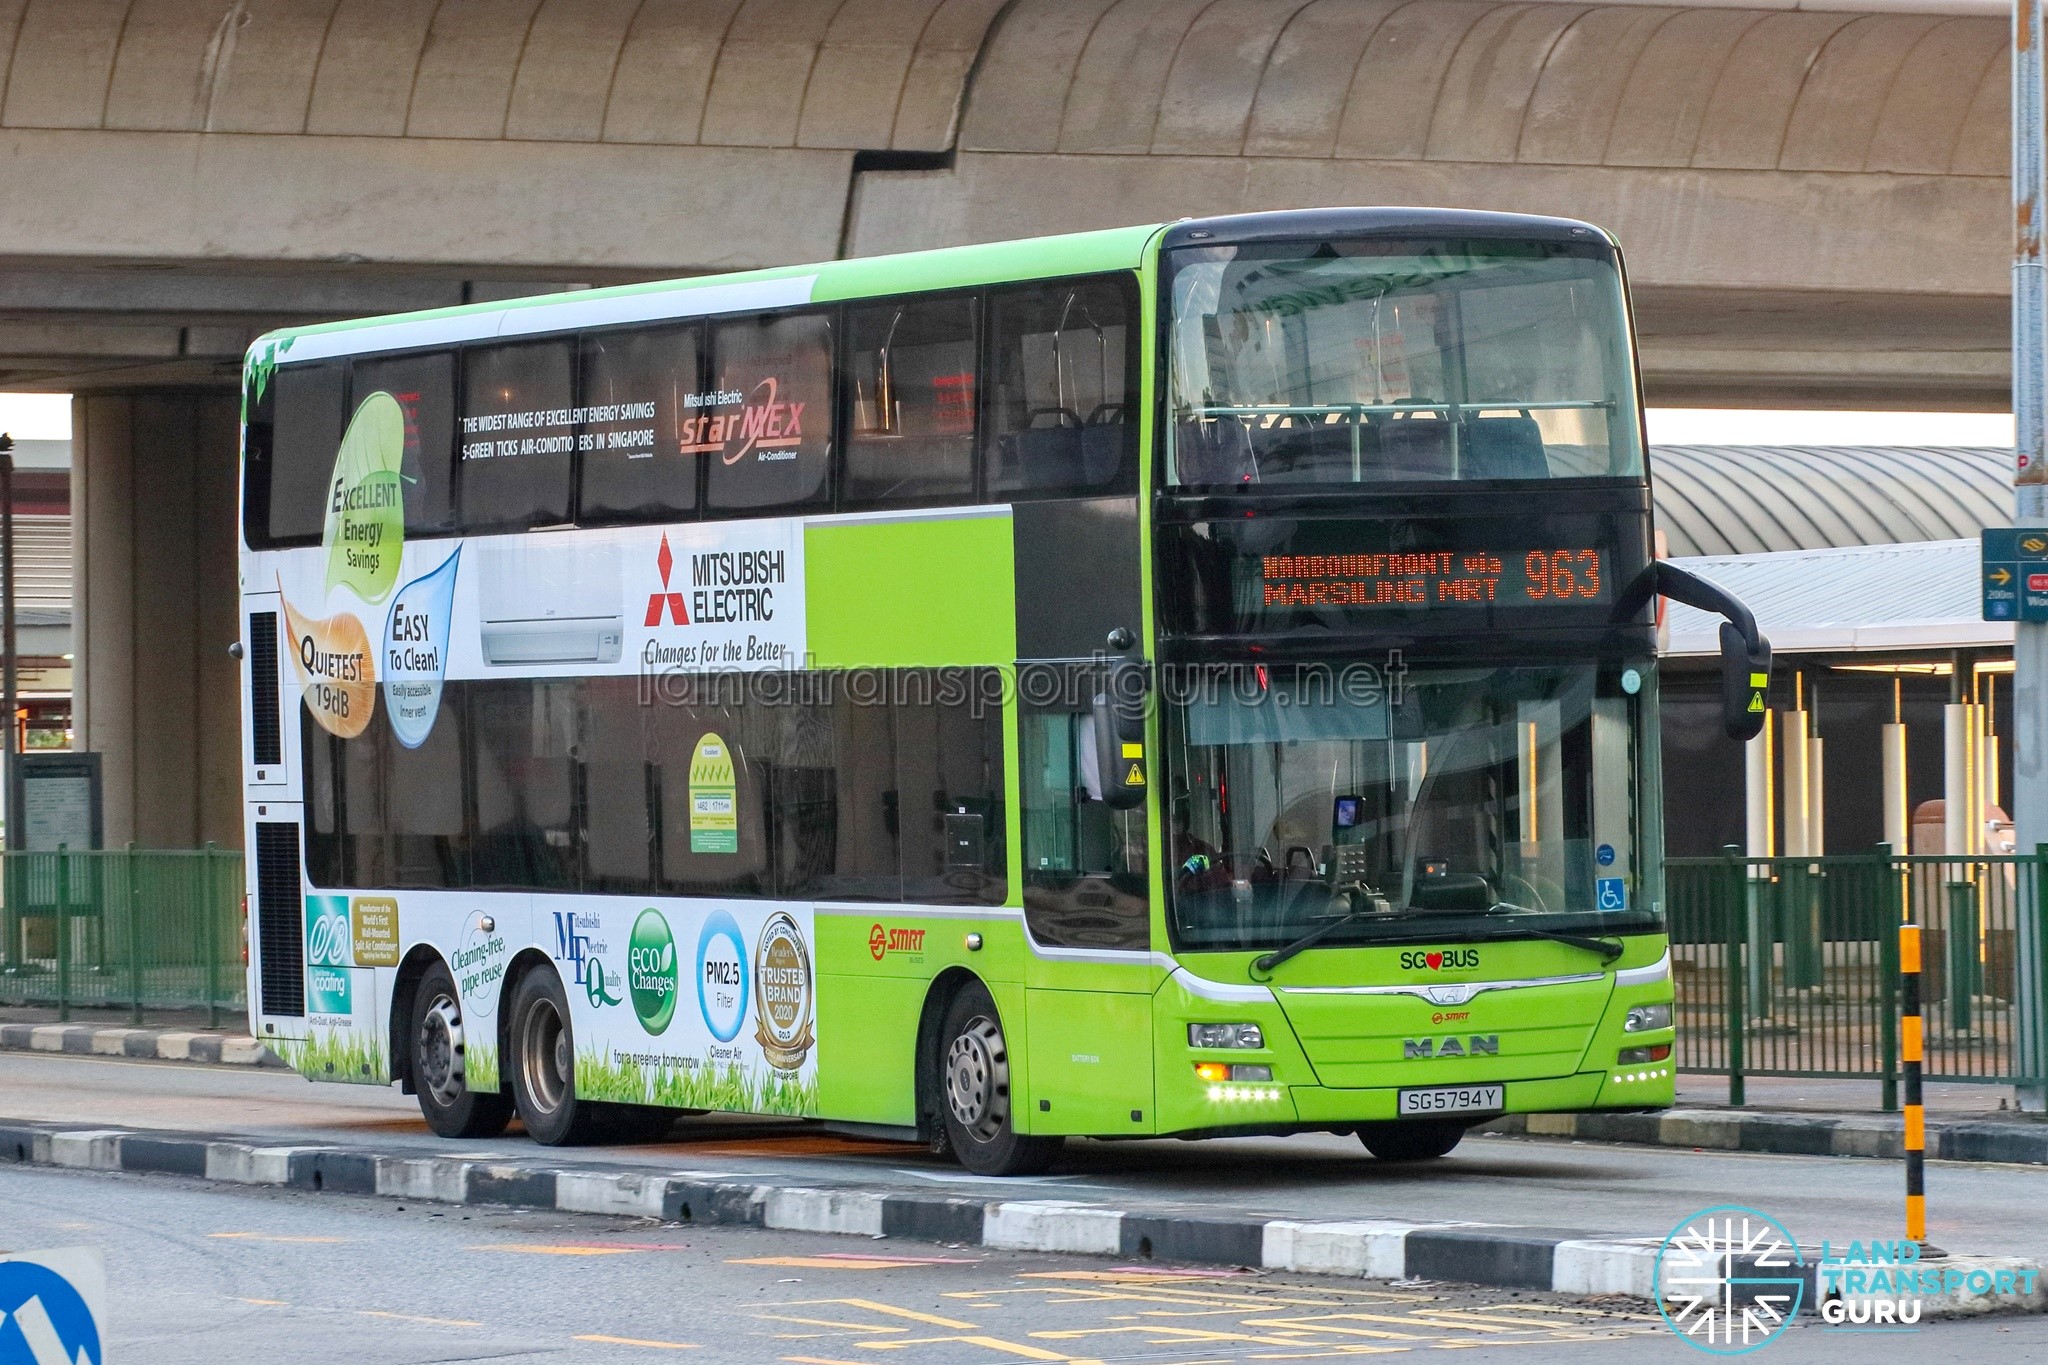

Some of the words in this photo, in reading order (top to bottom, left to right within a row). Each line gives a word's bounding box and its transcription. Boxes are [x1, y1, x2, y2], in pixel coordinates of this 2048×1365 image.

[717, 389, 743, 405] Electric
[463, 417, 478, 433] THE
[478, 414, 507, 432] WIDEST
[507, 412, 533, 429] RANGE
[534, 411, 546, 427] OF
[546, 408, 588, 426] EXCELLENT
[588, 404, 620, 423] ENERGY
[620, 402, 655, 420] SAVINGS
[462, 441, 494, 460] 5-GREEN
[497, 439, 518, 457] TICKS
[520, 434, 594, 455] AIR-CONDITIOERS
[596, 433, 607, 449] IN
[607, 429, 654, 448] SINGAPORE
[757, 450, 798, 462] Air-Conditioner
[331, 477, 397, 513] EXCELLENT
[344, 518, 384, 547] Energy
[346, 548, 380, 574] Savings
[692, 550, 785, 587] MITSUBISHI
[1524, 549, 1601, 600] 963
[693, 587, 774, 624] ELECTRIC
[1263, 580, 1425, 607] MARSILING
[1438, 578, 1499, 602] MRT
[392, 603, 429, 642] EASY
[301, 635, 364, 682] QUIETEST
[389, 649, 402, 671] To
[404, 646, 439, 672] Clean!
[644, 638, 697, 668] Changes
[699, 640, 720, 666] for
[722, 639, 742, 661] the
[746, 635, 786, 661] Better
[315, 684, 350, 719] 19dB
[887, 928, 926, 951] SMRT
[450, 934, 506, 972] Cleaning-free,
[631, 947, 661, 973] eco
[1441, 949, 1480, 968] BUS
[314, 973, 345, 997] coating
[461, 968, 480, 1000] pipe
[480, 963, 503, 983] reuse
[632, 969, 675, 997] Changes
[706, 961, 740, 986] PM2.5
[760, 967, 806, 985] TRUSTED
[716, 992, 734, 1009] Filter
[767, 986, 801, 1004] BRAND
[774, 1005, 793, 1021] 2020
[1445, 1011, 1471, 1021] SMRT
[613, 1049, 624, 1064] for
[626, 1054, 631, 1064] a
[632, 1053, 661, 1069] greener
[662, 1053, 700, 1070] tomorrow
[709, 1044, 732, 1060] Cleaner
[733, 1046, 742, 1060] Air
[1403, 1034, 1499, 1059] MAN
[1407, 1088, 1497, 1110] SG5794Y
